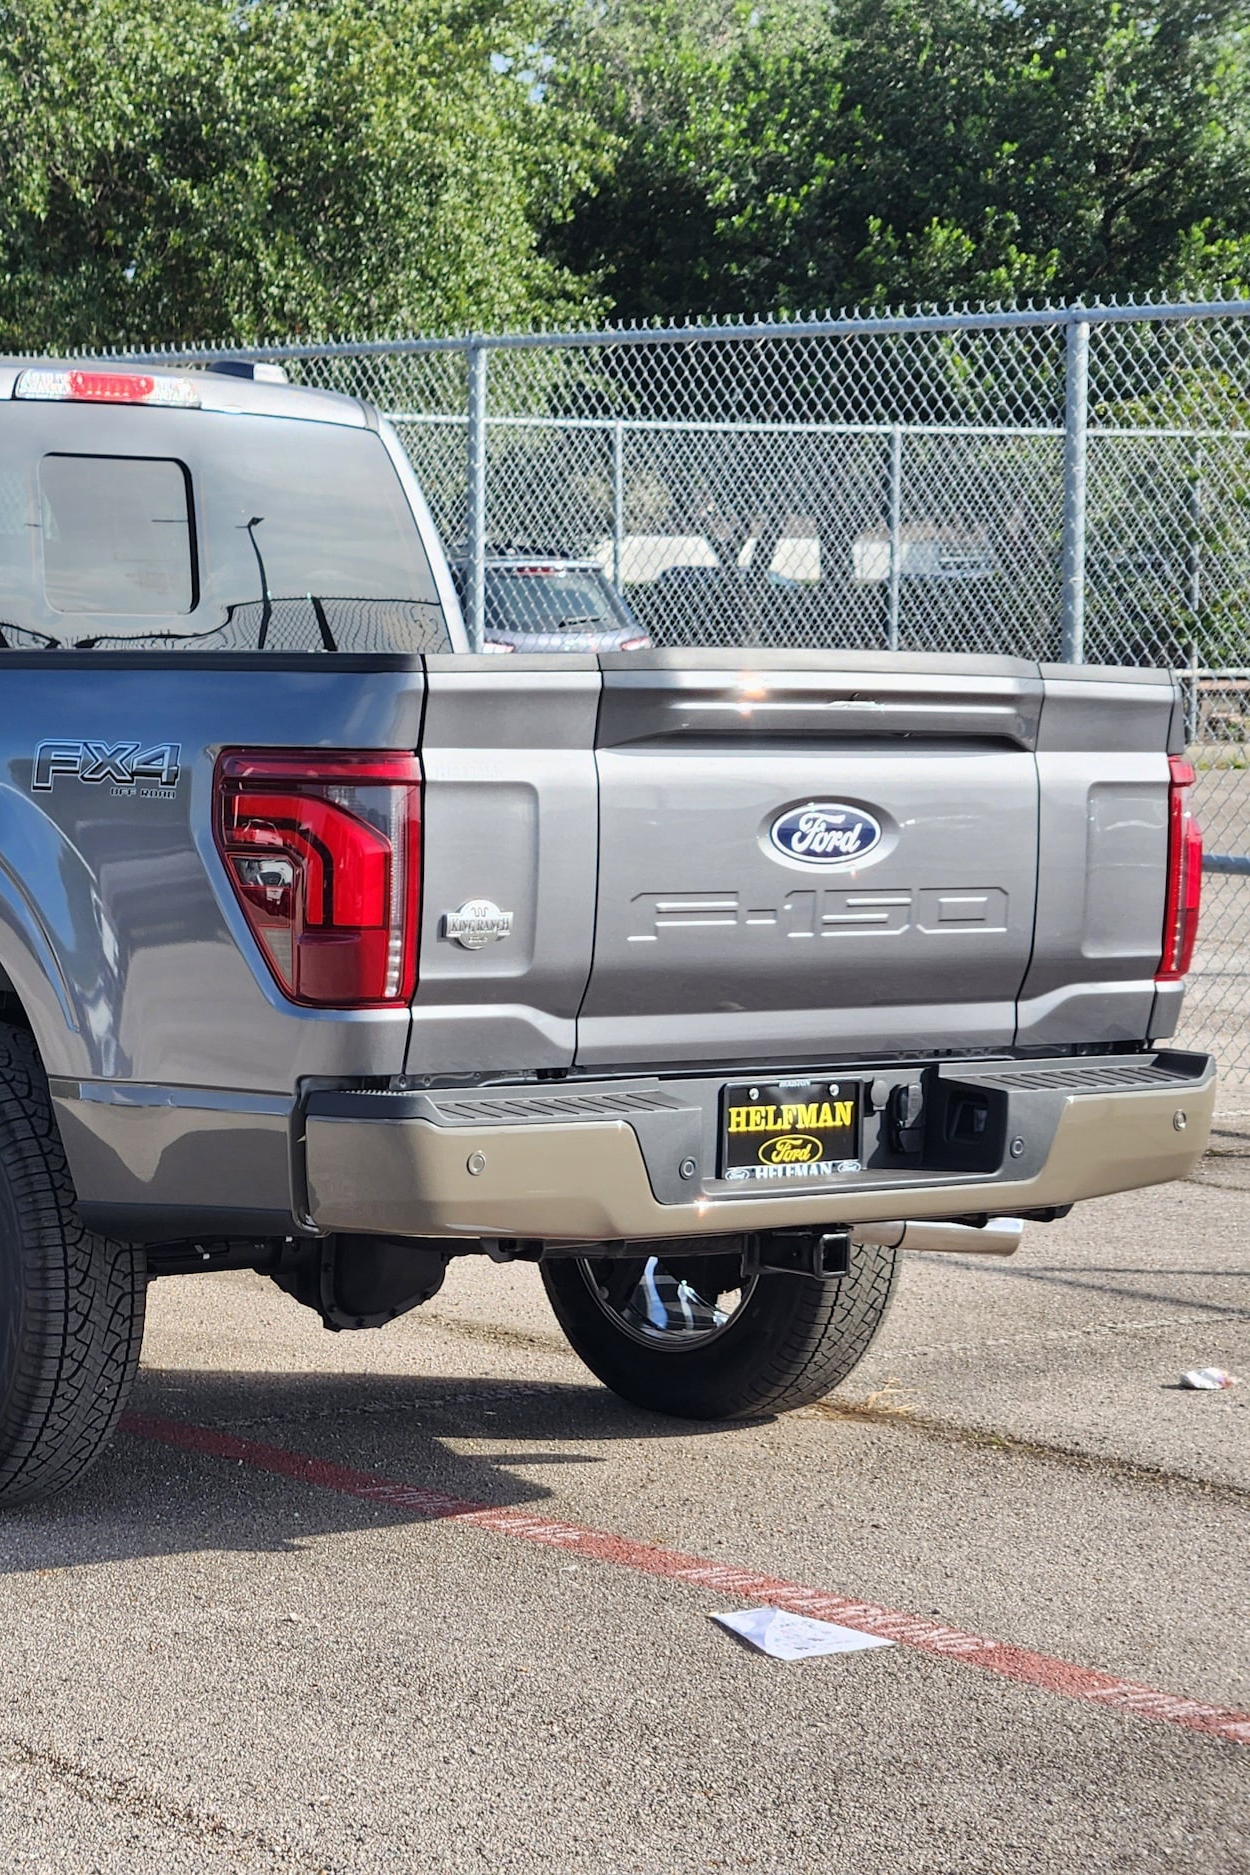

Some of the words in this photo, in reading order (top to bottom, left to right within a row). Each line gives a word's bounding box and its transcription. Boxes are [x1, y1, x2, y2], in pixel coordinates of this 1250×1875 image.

[31, 738, 182, 792] FX4
[110, 786, 137, 797] OFF
[140, 788, 177, 799] ROAD
[791, 811, 863, 853] Ford
[626, 887, 1009, 941] F-150
[728, 1101, 854, 1132] HELFMAN
[771, 1138, 812, 1163] Ford
[754, 1162, 834, 1179] HELFMAN
